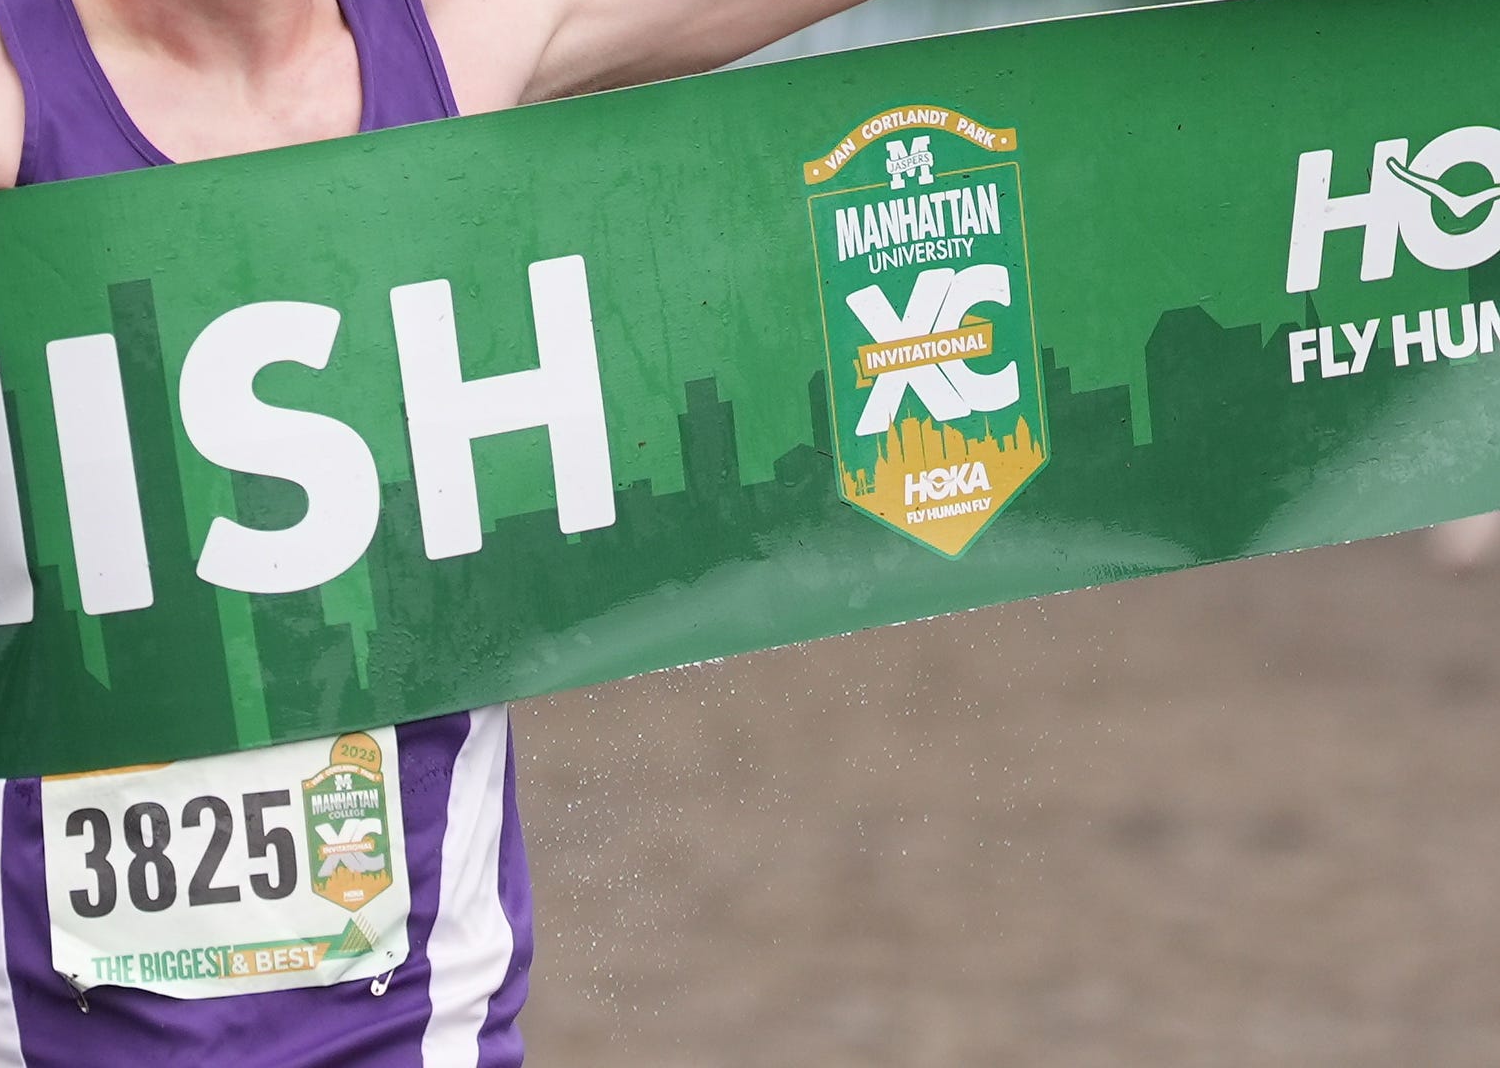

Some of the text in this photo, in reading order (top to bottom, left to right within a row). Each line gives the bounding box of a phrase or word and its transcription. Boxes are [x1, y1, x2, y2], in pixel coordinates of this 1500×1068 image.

[824, 109, 996, 171] VAN CORTLANDT PARK
[889, 153, 931, 173] JASPERS
[835, 183, 1001, 262] MANHATTAN
[868, 238, 974, 274] UNIVERSITY
[845, 264, 1020, 436] XC
[866, 333, 988, 370] INVITATIONAL
[1288, 317, 1381, 384] FLY
[904, 461, 990, 506] HOKA
[906, 497, 992, 524] FLY HUMAN FLY
[341, 744, 376, 762] 2025
[312, 788, 379, 815] MANHATTAN
[328, 809, 366, 821] COLLEGE
[65, 789, 298, 919] 3825
[314, 818, 385, 877] XC
[91, 945, 318, 983] THE BIGGEST & BEST
